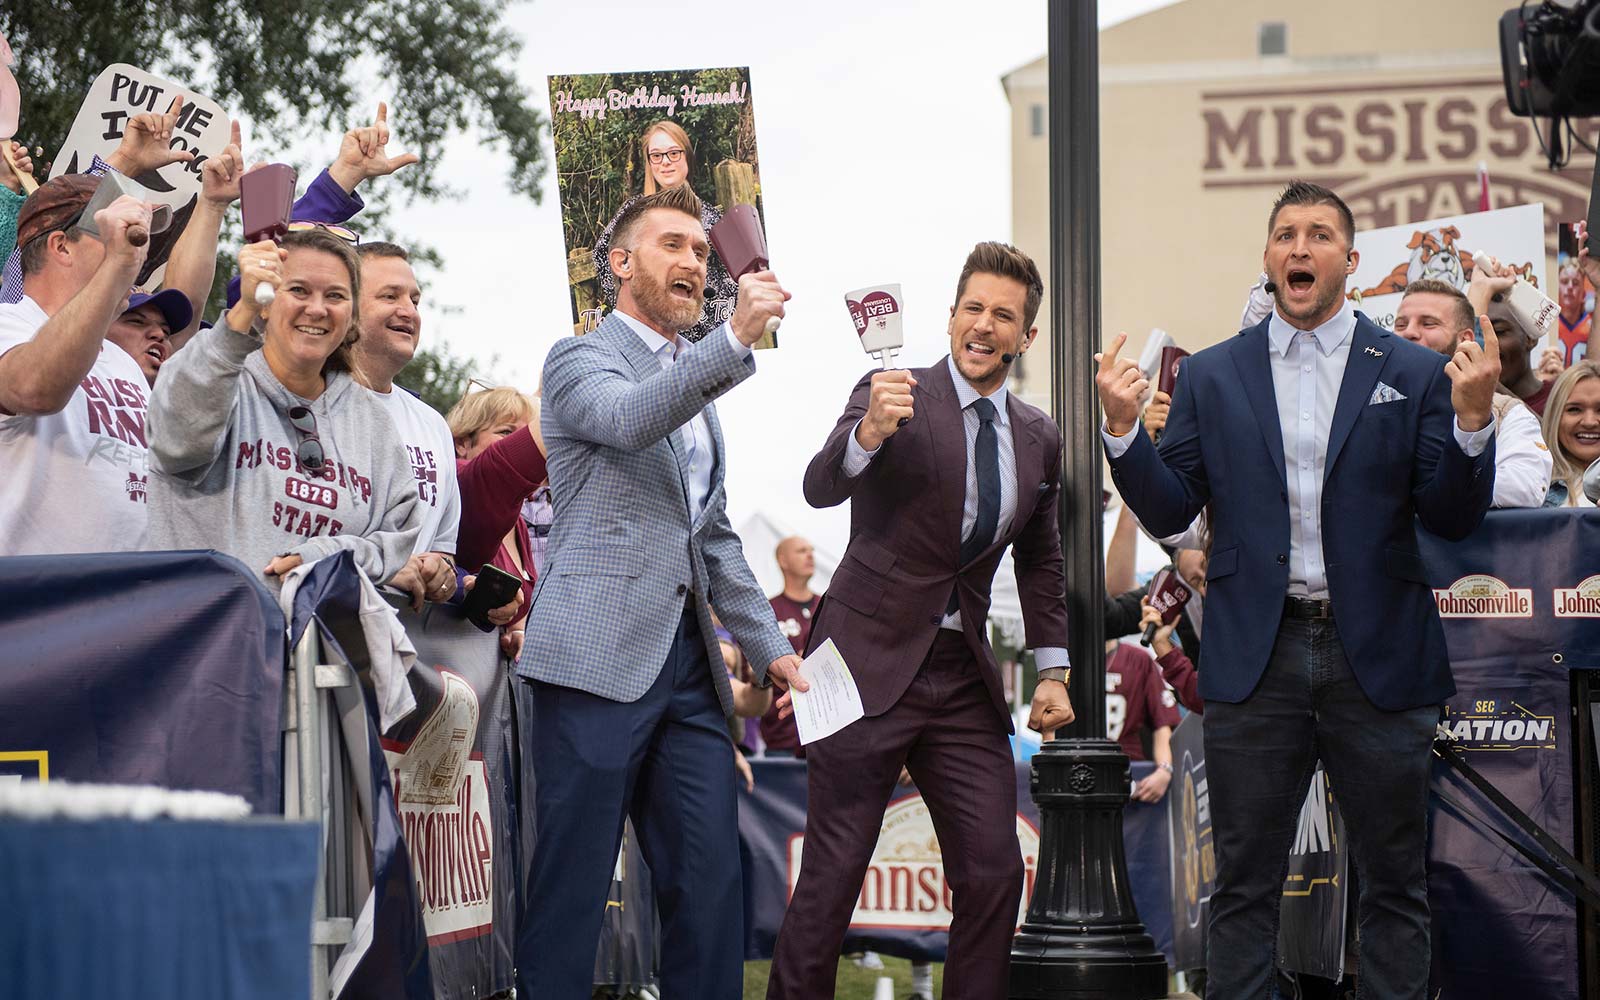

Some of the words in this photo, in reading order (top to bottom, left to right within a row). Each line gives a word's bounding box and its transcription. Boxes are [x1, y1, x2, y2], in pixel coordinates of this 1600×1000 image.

[110, 72, 165, 113] PUT
[165, 95, 214, 139] ME
[556, 90, 608, 120] Happy
[607, 85, 677, 117] Birthday
[680, 81, 748, 108] Hannah!
[100, 110, 132, 142] I
[1202, 96, 1598, 171] MISSISS
[865, 302, 894, 317] BEAT
[84, 436, 149, 472] REP
[235, 438, 372, 504] MISSSIPP
[290, 480, 333, 504] 1878
[271, 500, 343, 538] STATE
[1557, 591, 1600, 614] Johns
[1475, 700, 1496, 714] SEC
[394, 767, 492, 913] nsonville
